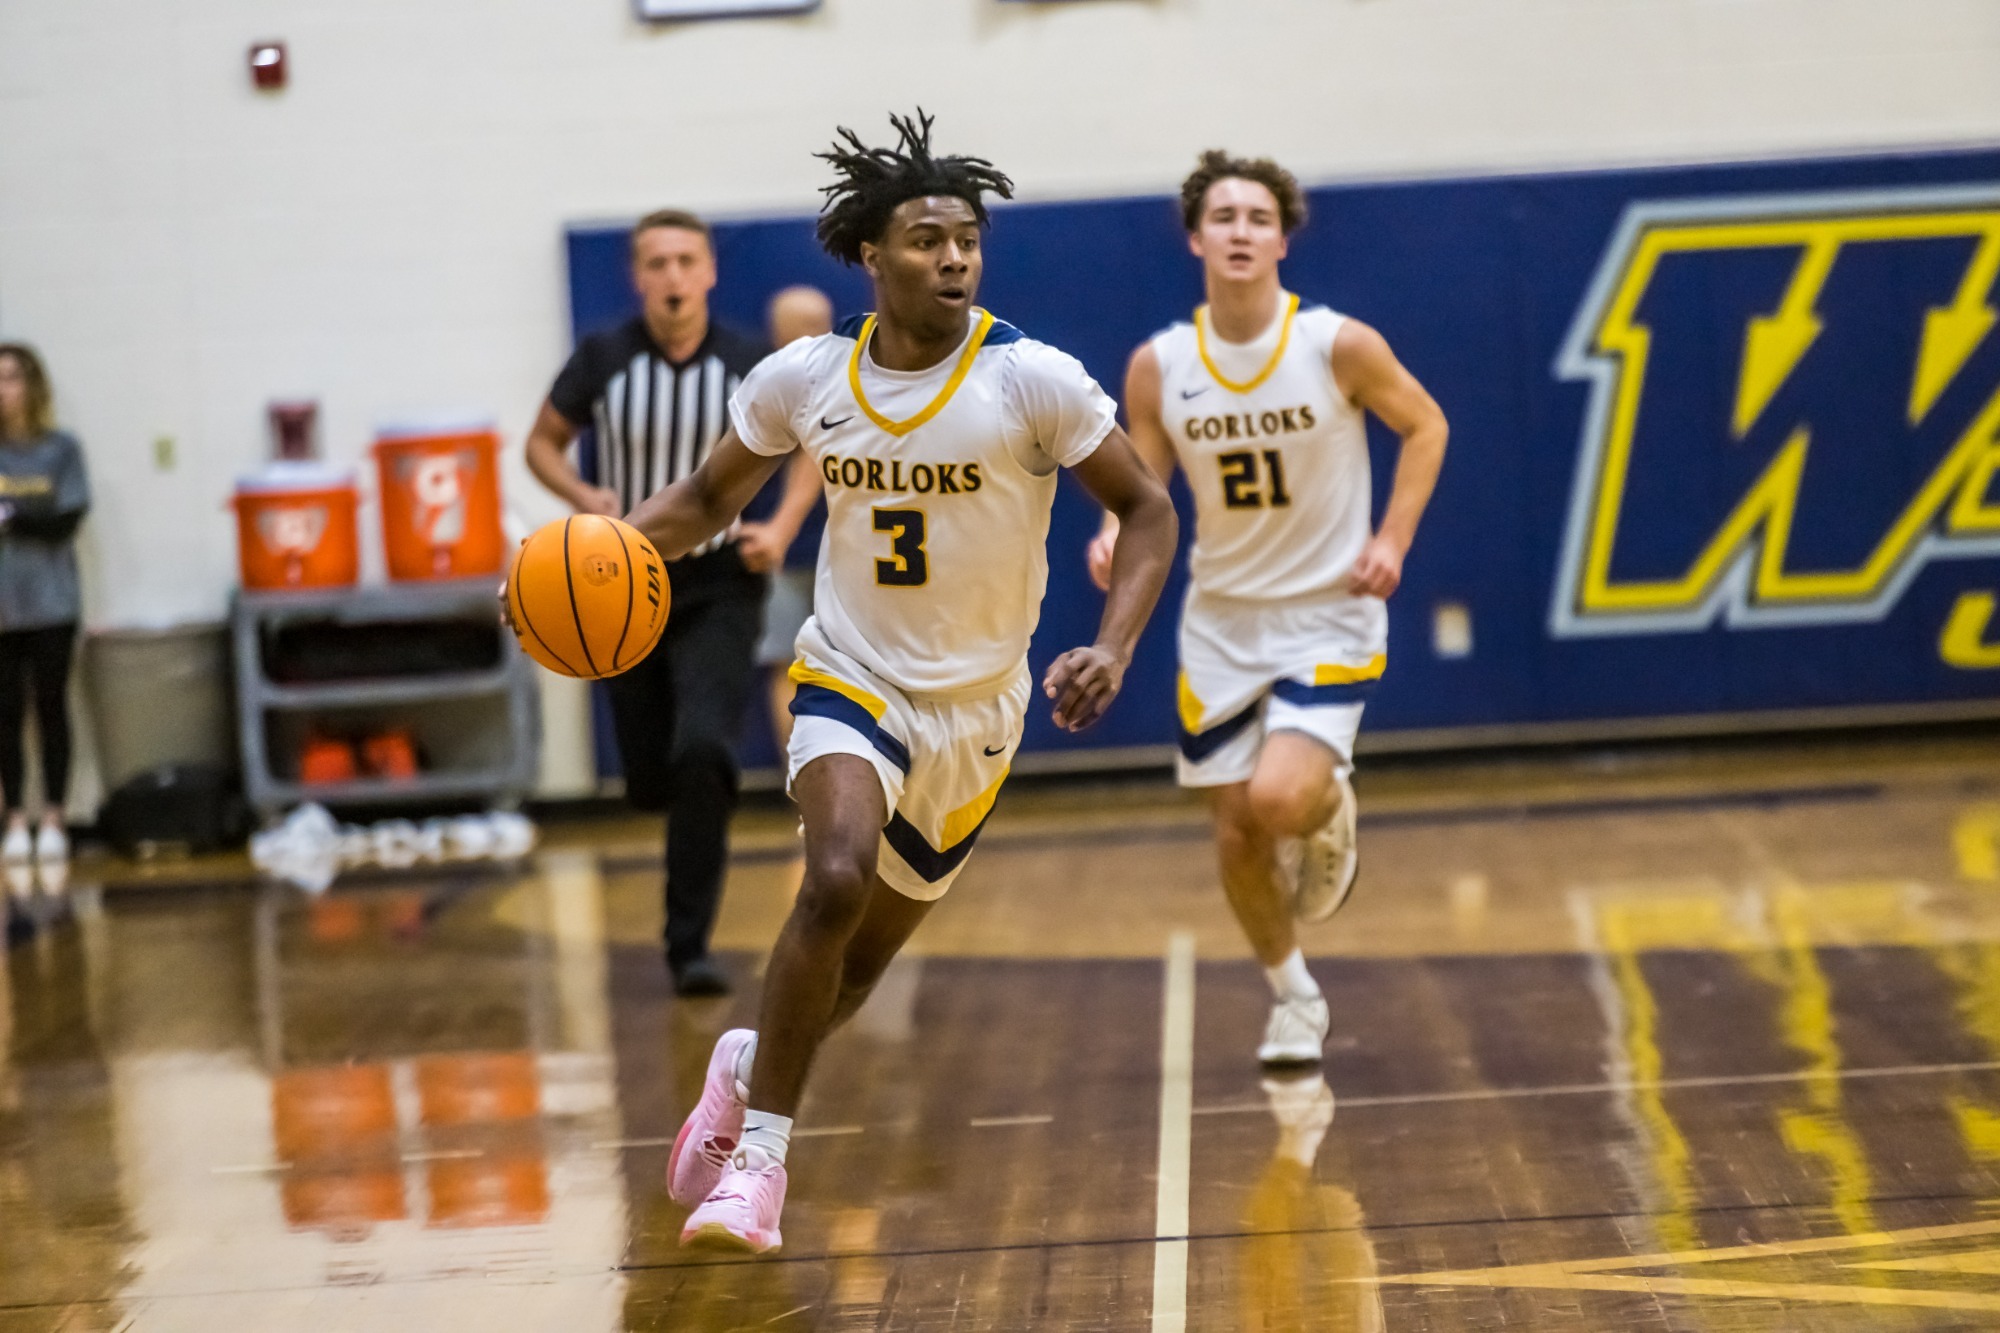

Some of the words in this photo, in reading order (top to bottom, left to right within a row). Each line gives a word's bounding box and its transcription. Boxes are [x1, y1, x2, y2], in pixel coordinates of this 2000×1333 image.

[1184, 404, 1316, 441] GORLOKS
[1550, 188, 2000, 638] W
[822, 455, 982, 494] GORLOKS
[1217, 449, 1291, 509] 21
[871, 506, 930, 587] 3
